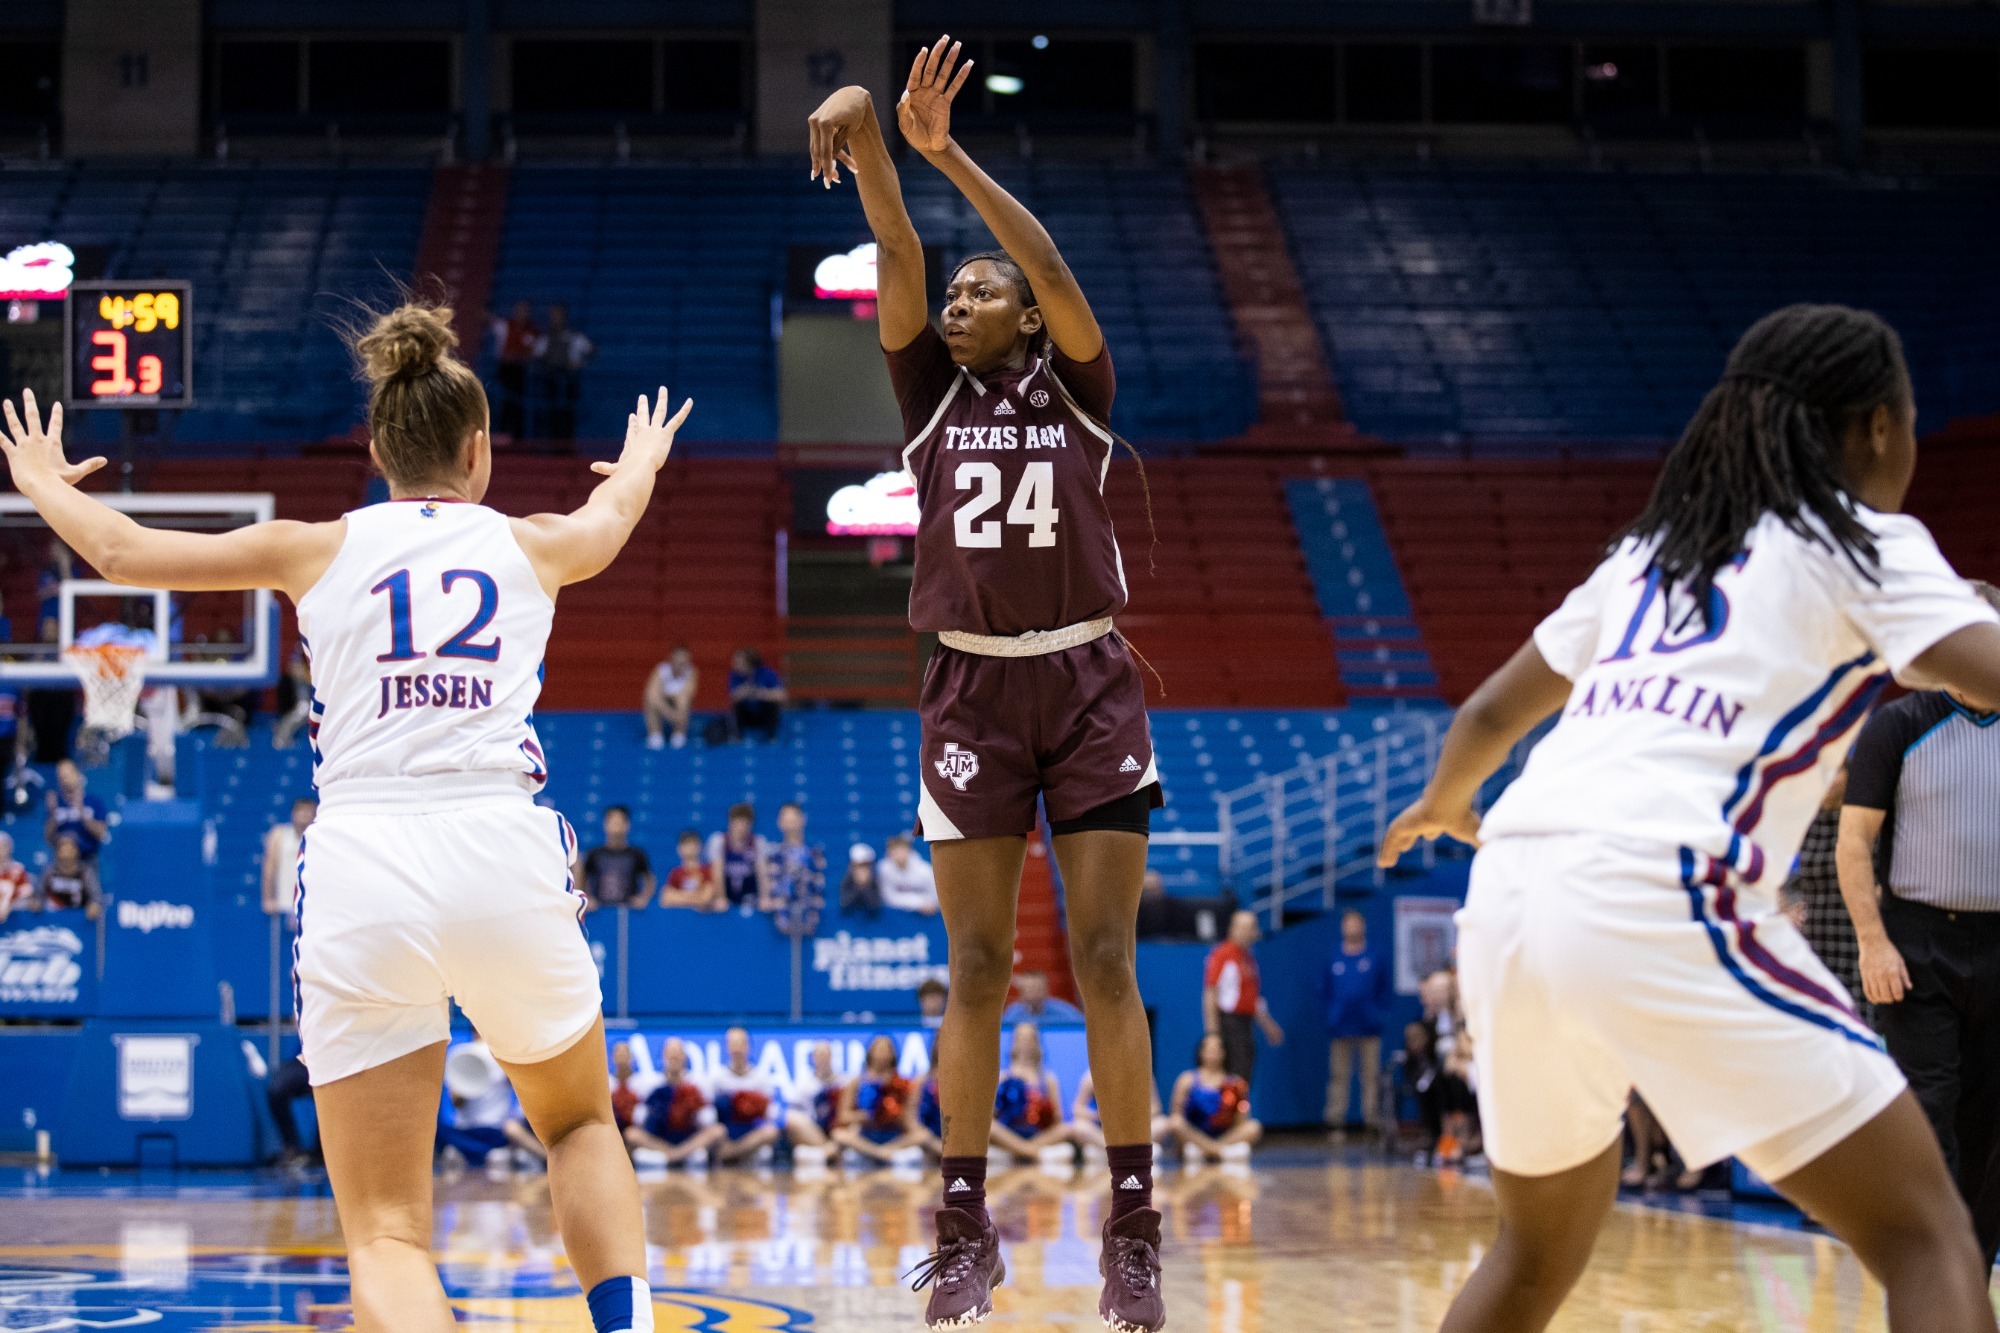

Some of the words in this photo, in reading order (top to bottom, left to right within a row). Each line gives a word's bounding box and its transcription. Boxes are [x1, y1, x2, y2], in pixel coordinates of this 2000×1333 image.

[99, 292, 179, 332] 4:59
[91, 330, 162, 395] 3.3
[994, 408, 1016, 416] adidas
[946, 425, 1018, 450] TEXAS
[1025, 424, 1067, 449] A&M
[953, 461, 1060, 548] 24
[371, 568, 501, 663] 12
[377, 673, 493, 719] JESSEN
[1119, 764, 1142, 772] adidas
[813, 930, 928, 972] planet
[949, 1185, 971, 1193] adidas
[1120, 1182, 1143, 1190] adidas
